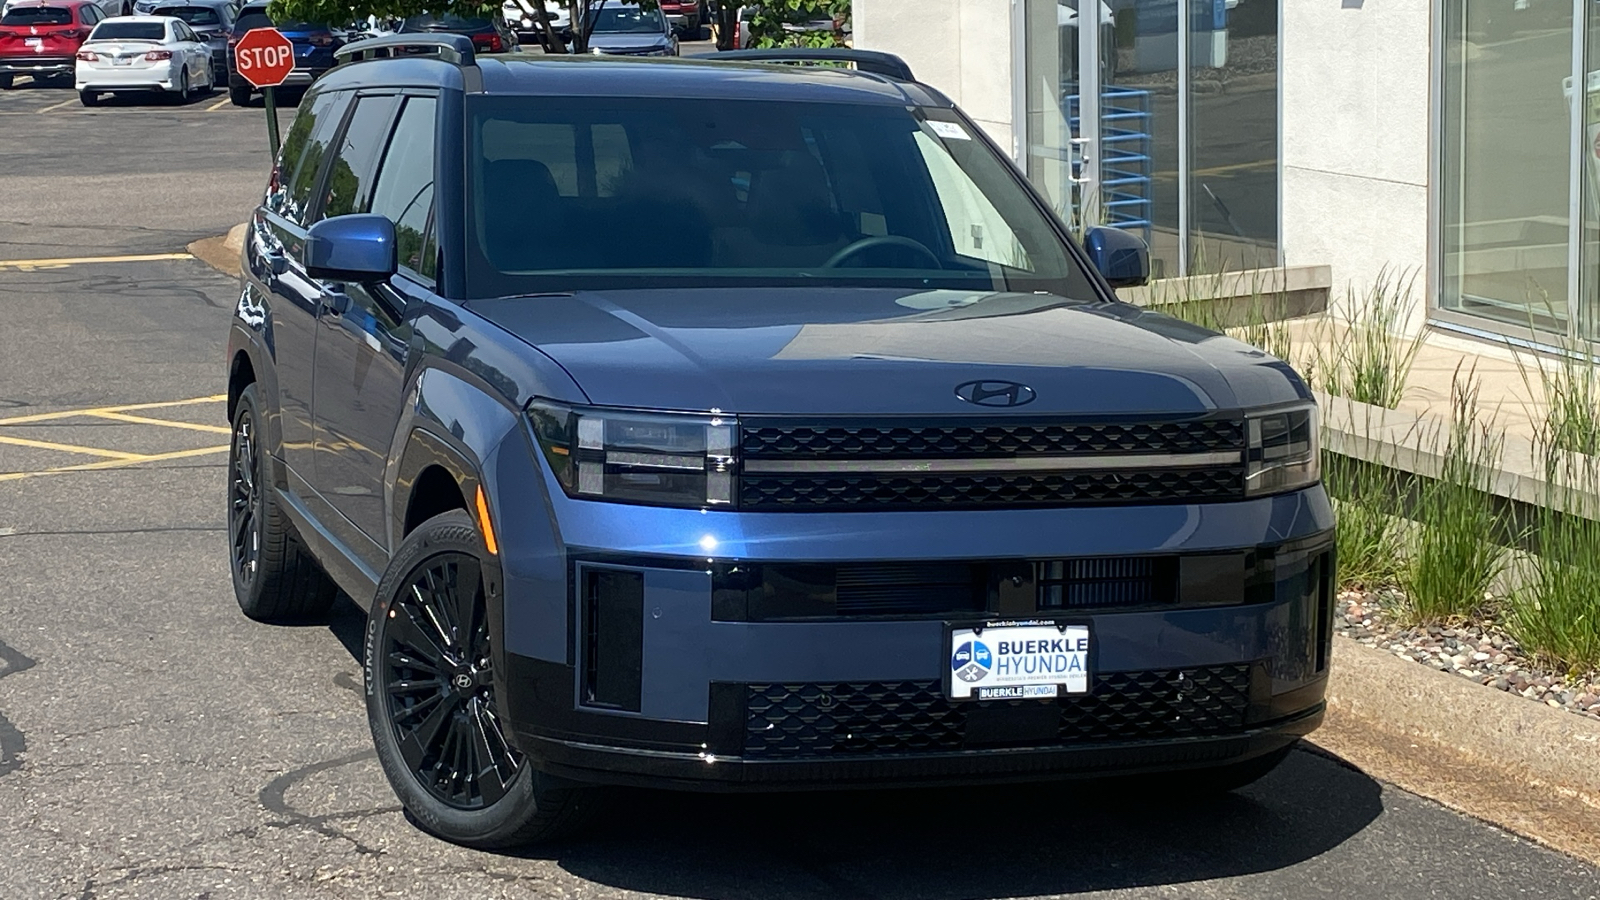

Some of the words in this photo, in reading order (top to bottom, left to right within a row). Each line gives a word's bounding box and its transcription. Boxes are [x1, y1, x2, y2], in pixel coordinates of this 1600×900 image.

[239, 45, 291, 70] STOP
[366, 619, 376, 695] KUMHO
[998, 639, 1087, 655] BUERKLE
[997, 653, 1087, 675] HYUNDAI
[981, 687, 1023, 698] BUERKLE
[1024, 686, 1056, 696] HYUNDAI
